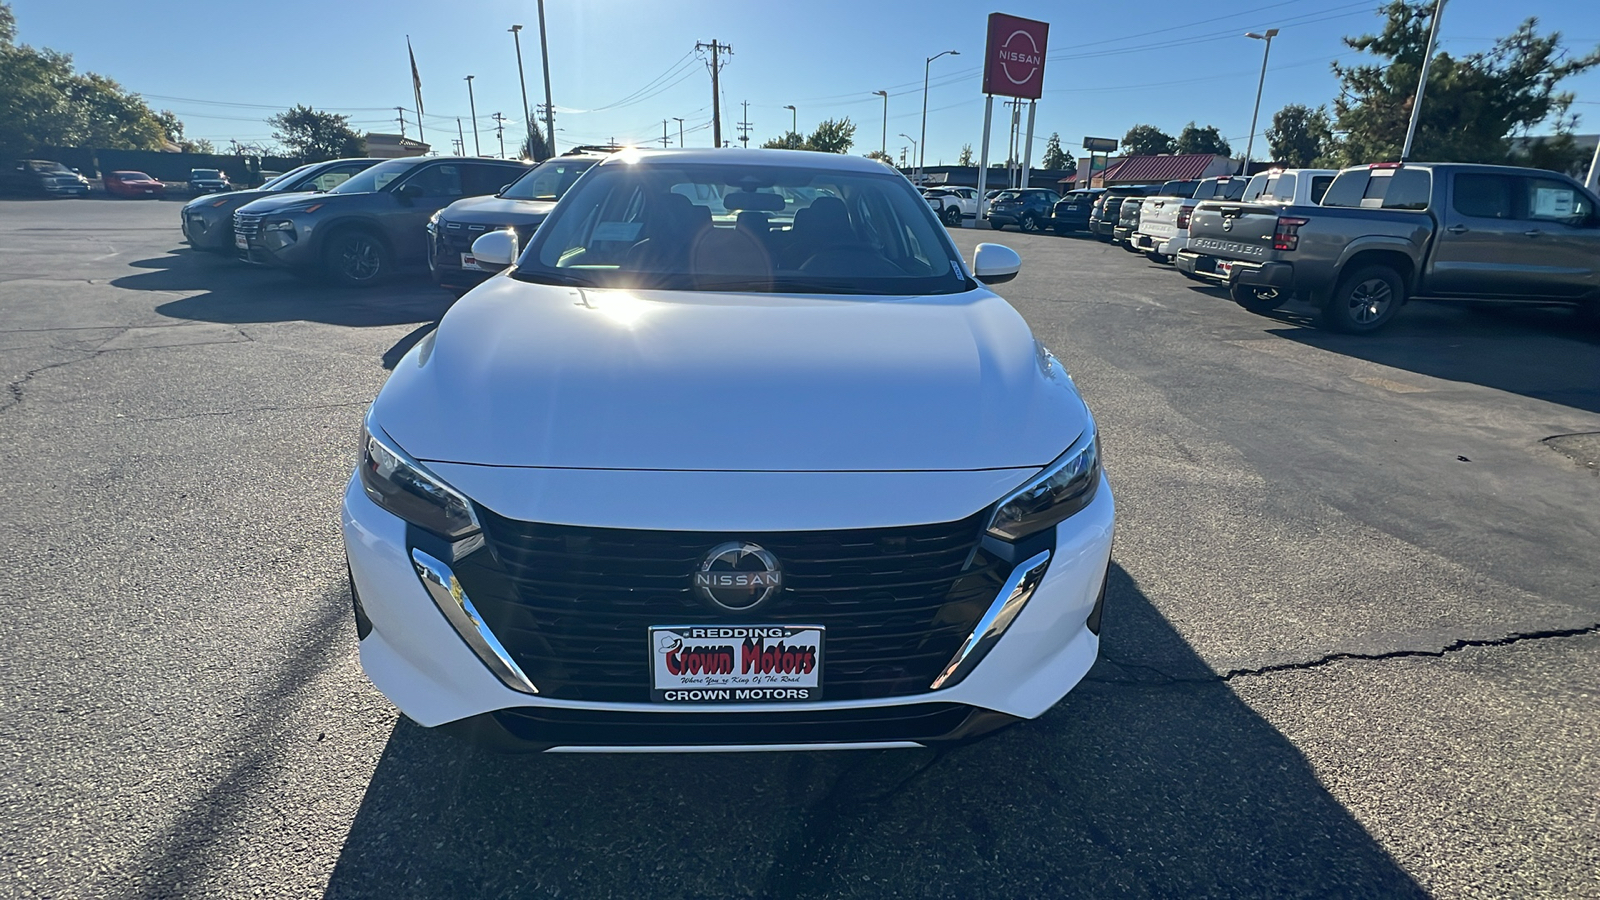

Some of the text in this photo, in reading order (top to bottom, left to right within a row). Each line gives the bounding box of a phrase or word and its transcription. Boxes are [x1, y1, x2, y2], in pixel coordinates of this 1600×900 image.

[999, 50, 1041, 65] NISSAN
[1195, 239, 1264, 256] FRONTIER
[697, 574, 779, 586] NISSAN
[692, 628, 783, 638] REDDING
[665, 637, 816, 676] Crown Motors
[680, 675, 801, 686] Where You're King Of The Road
[664, 689, 809, 700] CROWN MOTORS
